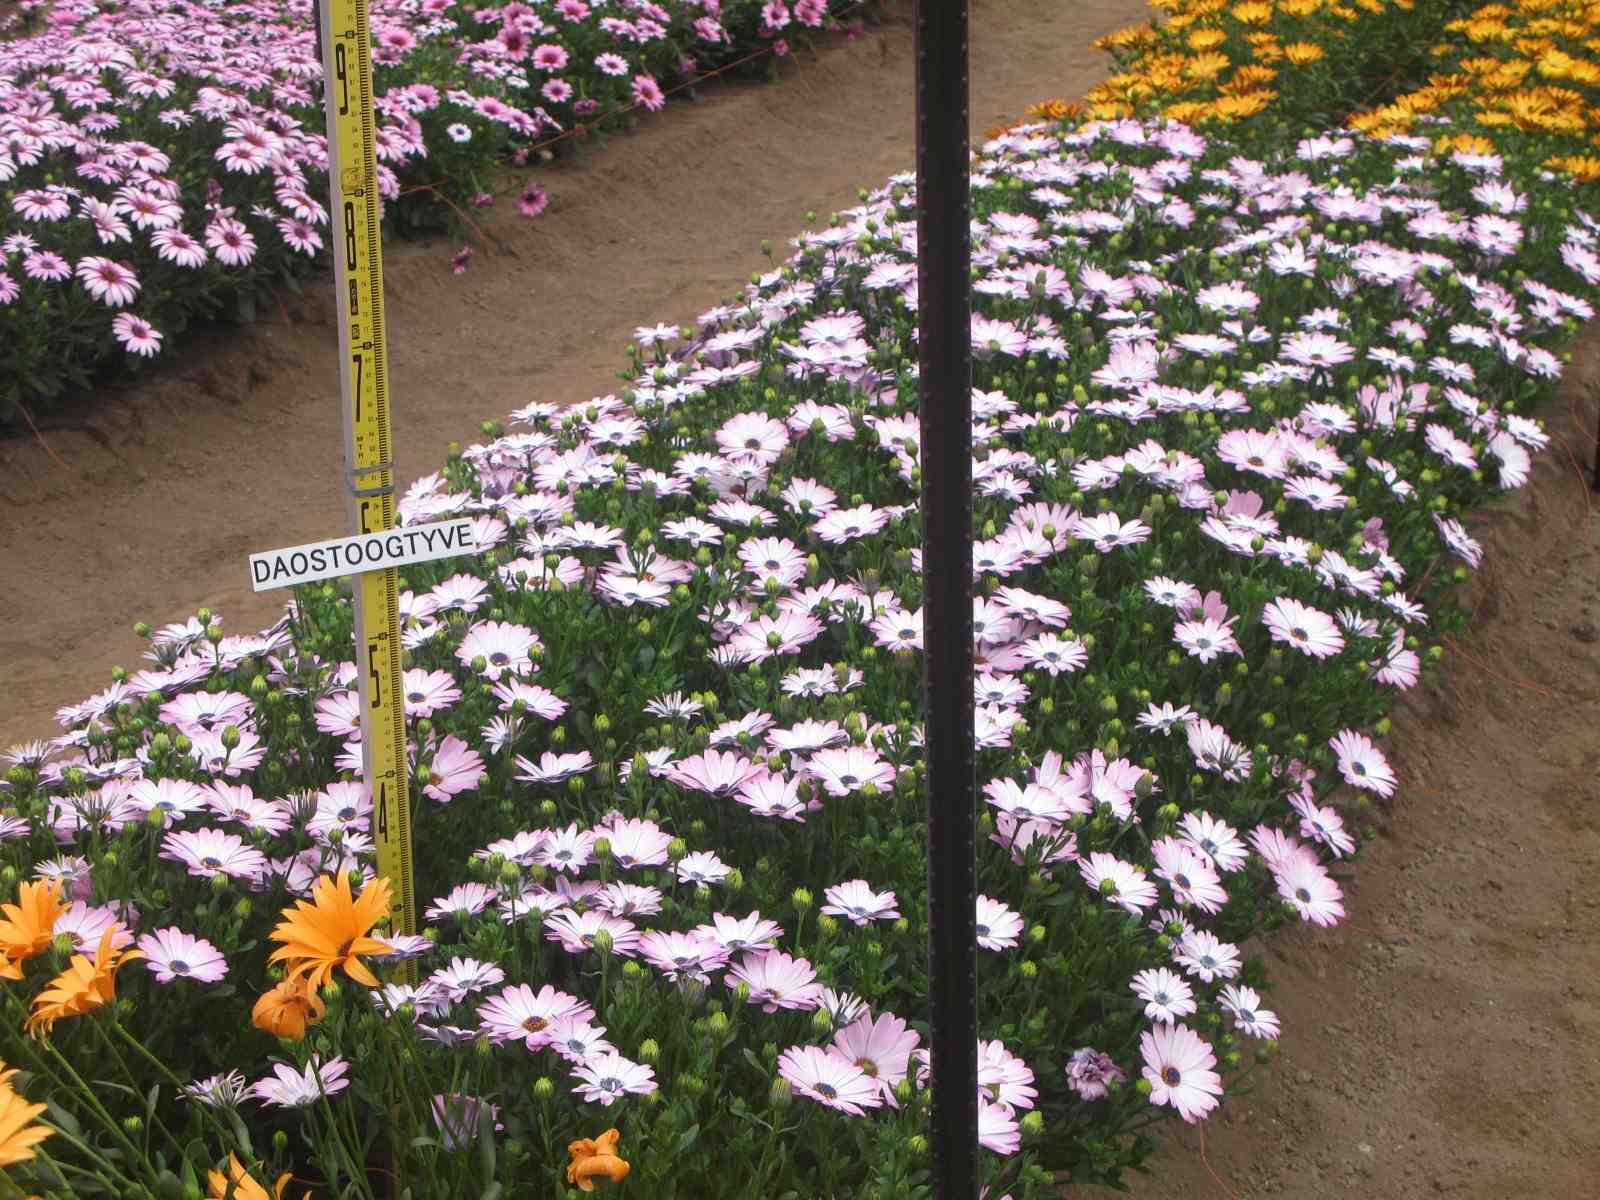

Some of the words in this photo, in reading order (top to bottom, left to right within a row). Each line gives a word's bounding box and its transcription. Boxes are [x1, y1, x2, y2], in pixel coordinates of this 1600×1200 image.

[336, 43, 348, 116] 9
[344, 201, 357, 271] 8
[352, 354, 362, 423] 7
[253, 523, 473, 583] DAOSTOOGTYVE
[368, 643, 381, 709] 5
[378, 782, 388, 843] 4
